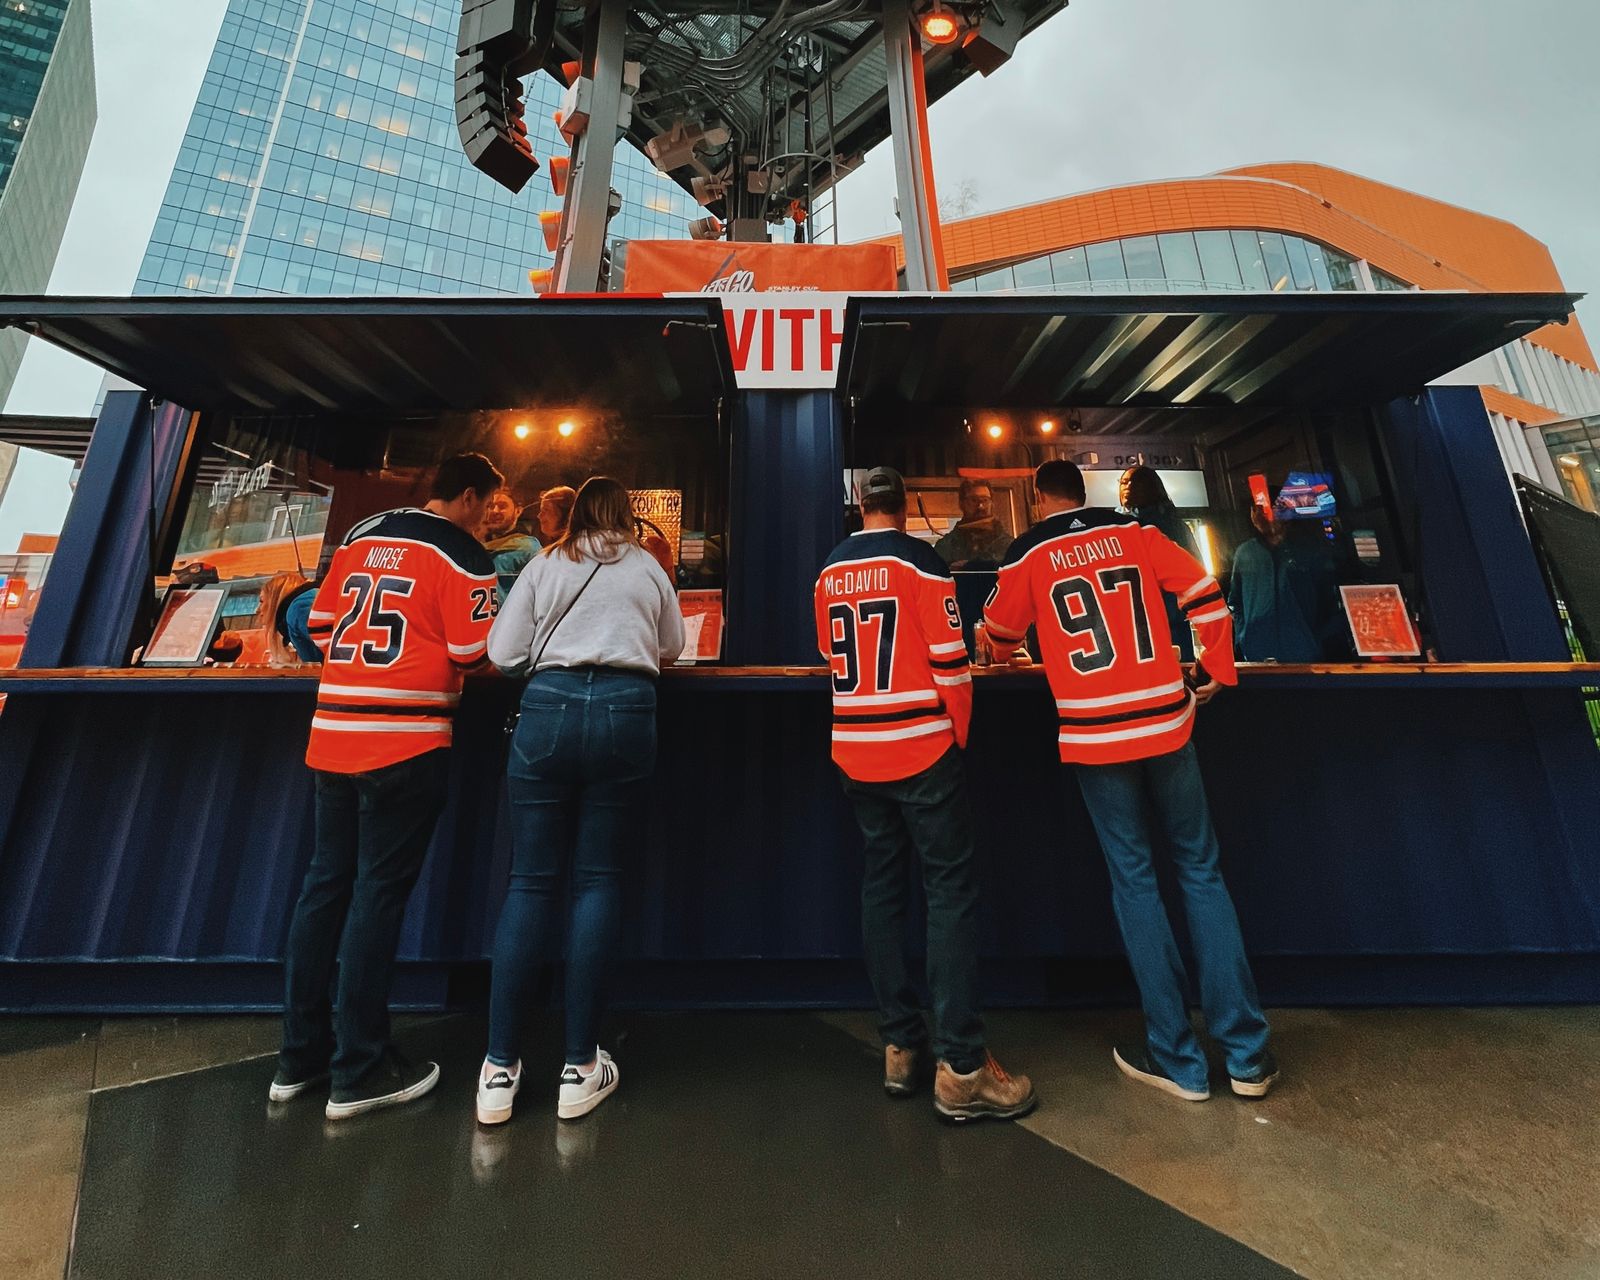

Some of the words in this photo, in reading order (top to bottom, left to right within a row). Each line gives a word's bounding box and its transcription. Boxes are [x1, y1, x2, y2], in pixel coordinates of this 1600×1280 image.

[363, 546, 409, 571] NURSE
[1049, 536, 1123, 572] McDAVID
[825, 567, 888, 597] McDAVID
[327, 572, 416, 668] 25
[470, 587, 500, 622] 25
[1050, 565, 1156, 676] 97
[828, 596, 898, 695] 97
